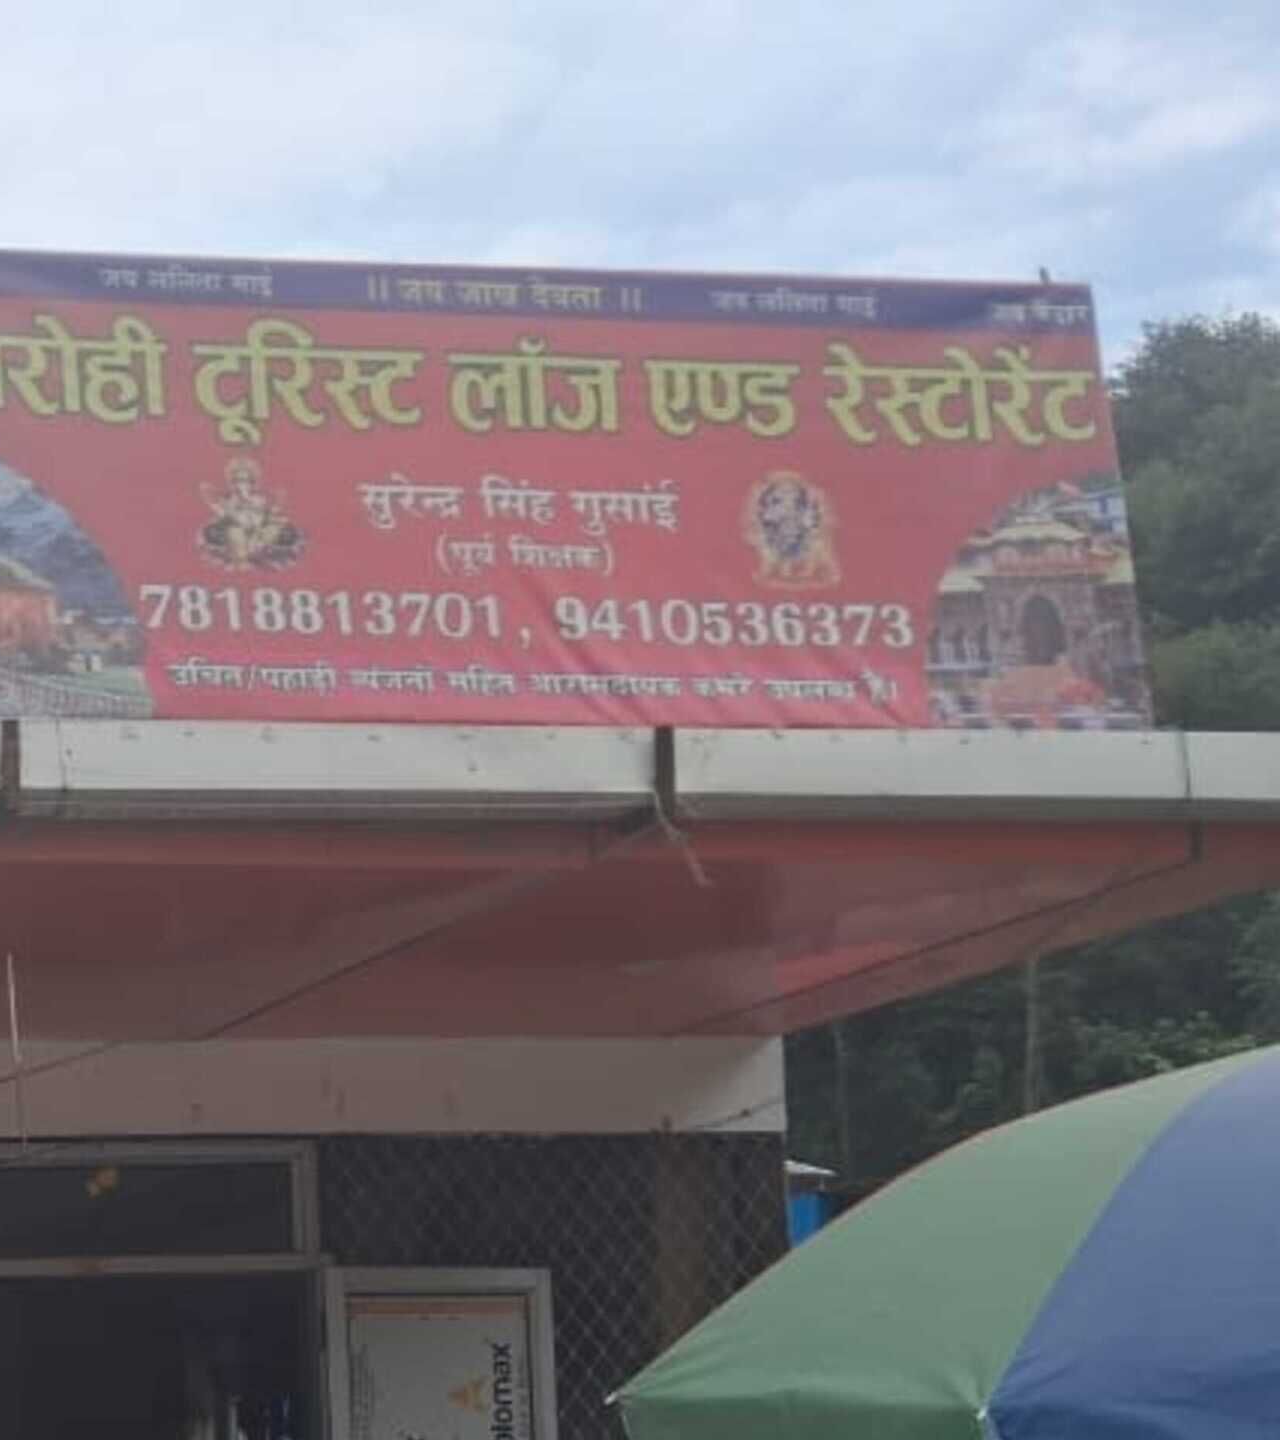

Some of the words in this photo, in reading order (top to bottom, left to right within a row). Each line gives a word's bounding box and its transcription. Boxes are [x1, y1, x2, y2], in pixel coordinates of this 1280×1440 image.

[192, 318, 424, 444] टूरिस्ट
[449, 337, 622, 433] लॉज
[643, 357, 800, 438] एण्ड
[822, 342, 1097, 446] रेस्टोरेंट
[355, 473, 465, 529] सुरेन्द्र
[480, 473, 557, 525] सिंह
[556, 597, 915, 649] 9410536373
